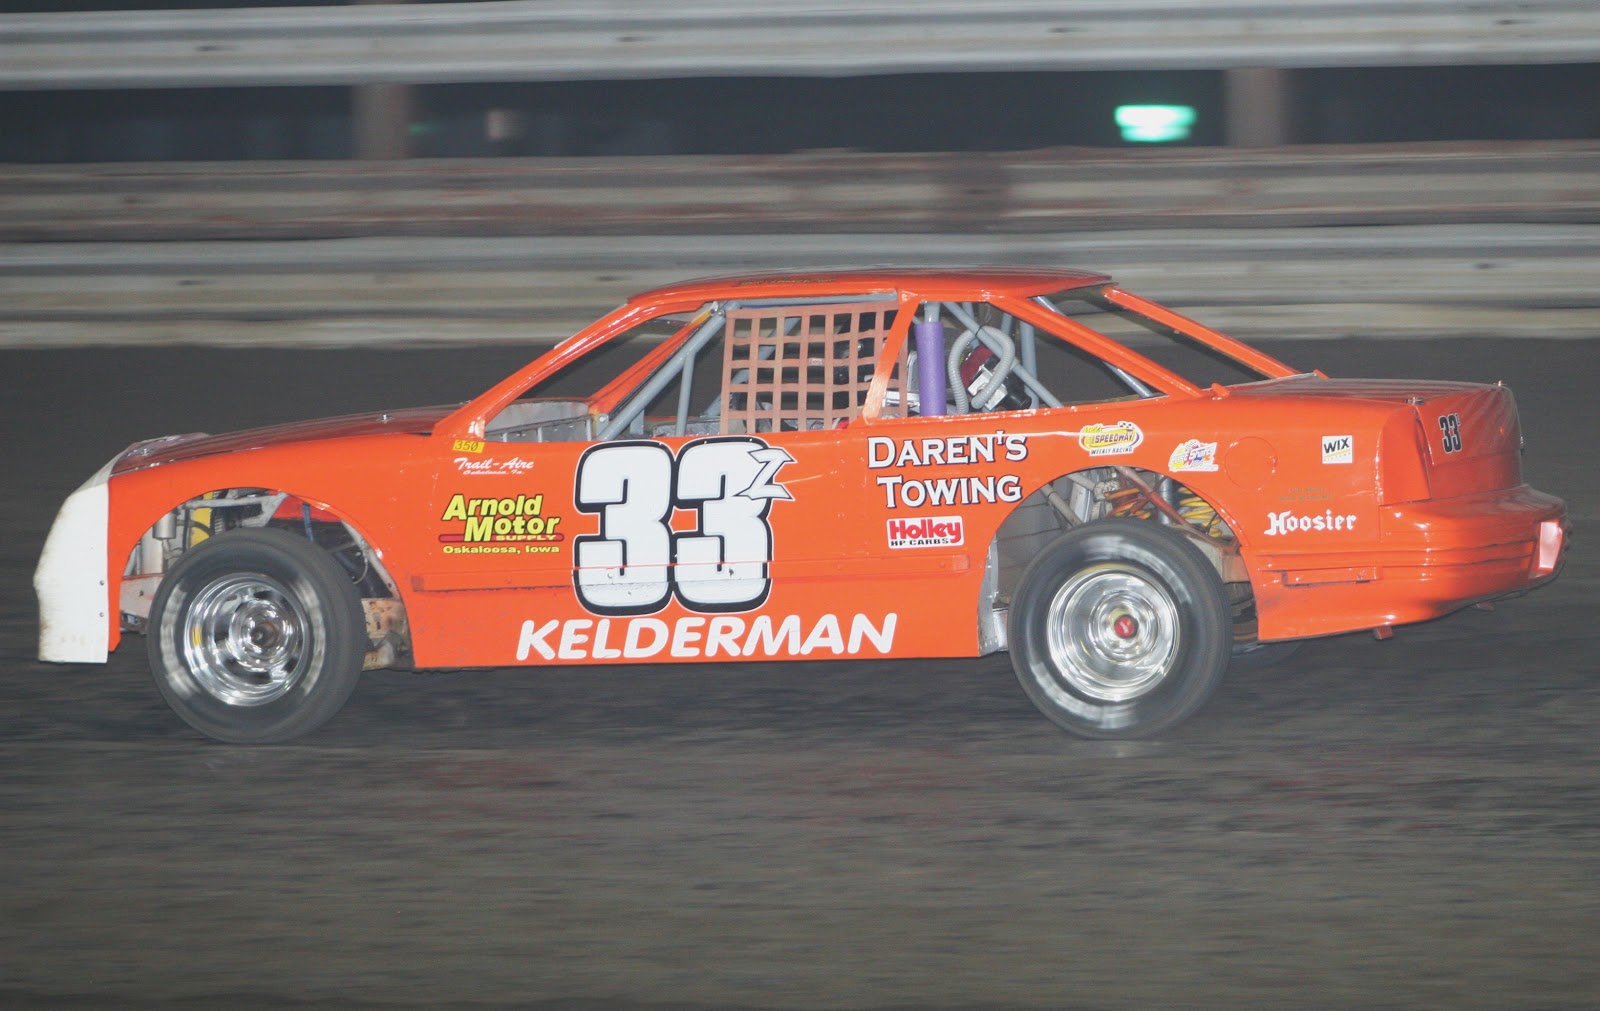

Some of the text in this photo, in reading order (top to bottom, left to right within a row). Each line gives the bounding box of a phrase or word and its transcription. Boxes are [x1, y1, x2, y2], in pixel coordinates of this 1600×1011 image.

[867, 430, 1028, 469] DAREN'S
[1094, 432, 1135, 444] SPEEDWAY
[1324, 437, 1350, 454] WIX
[876, 475, 1023, 509] TOWING
[441, 494, 543, 521] Arnold
[463, 515, 561, 542] Motor
[889, 518, 961, 544] Holley
[1263, 509, 1357, 536] Hoosier
[442, 545, 560, 554] Oskaloosa, Iowa
[908, 538, 950, 546] CARBS
[516, 612, 898, 661] KELDERMAN
